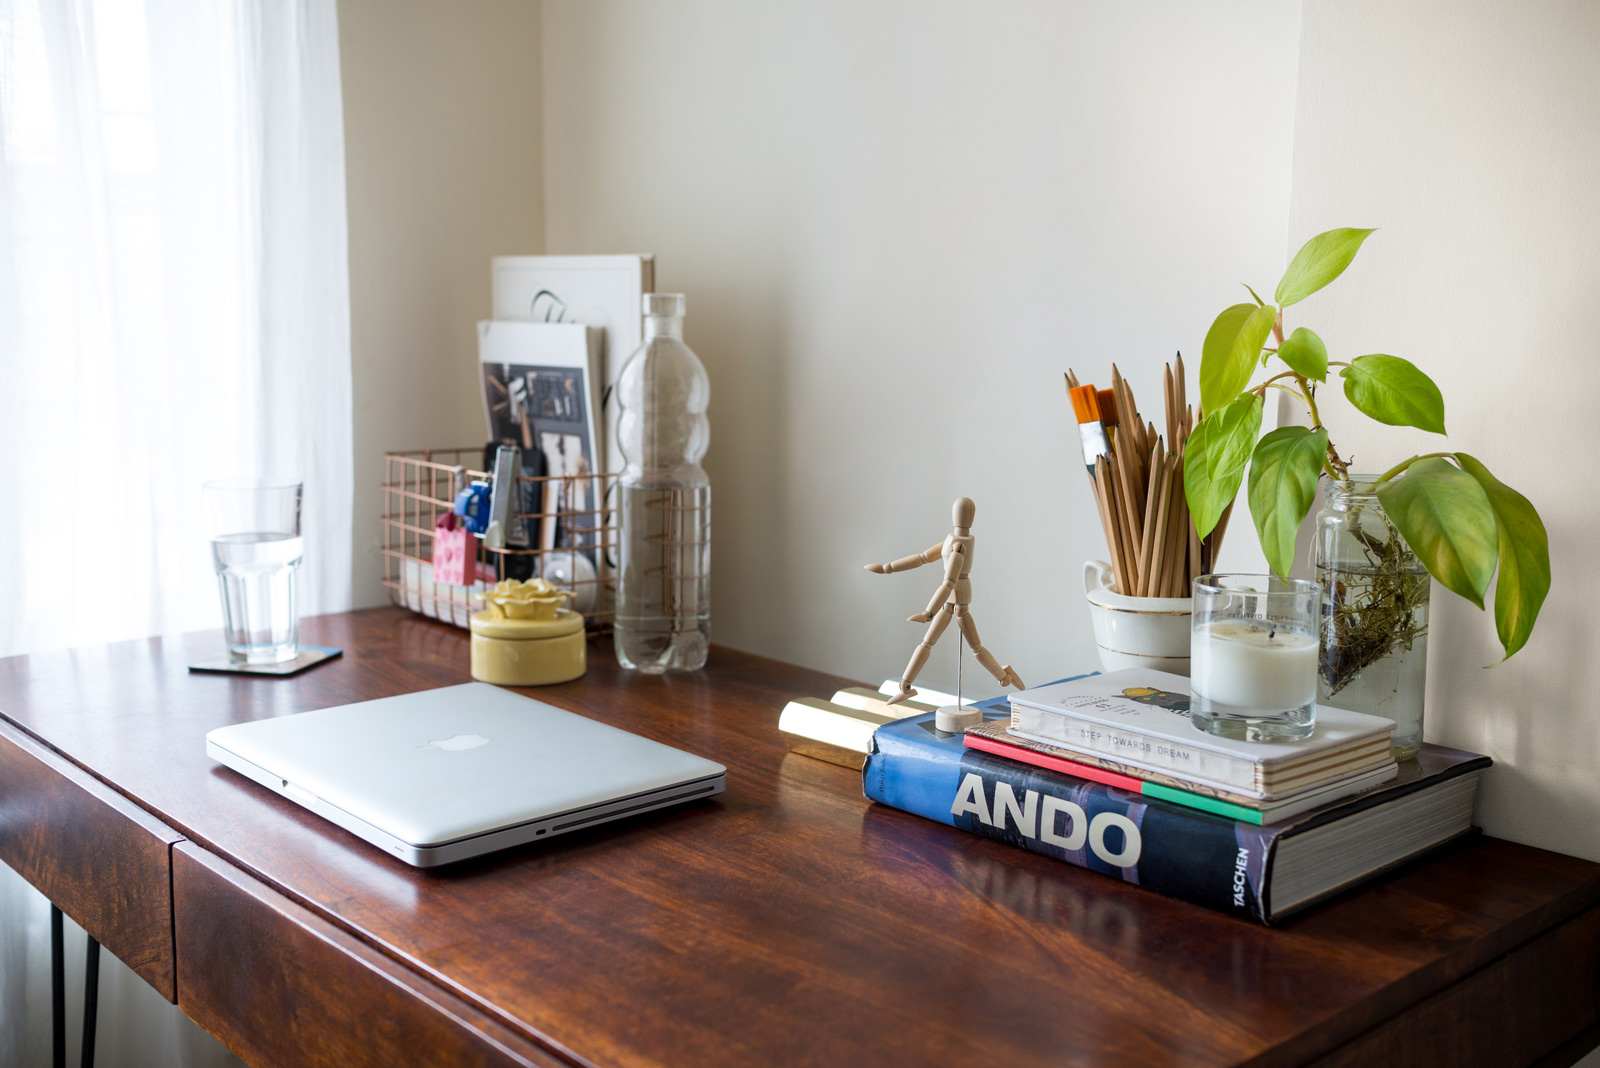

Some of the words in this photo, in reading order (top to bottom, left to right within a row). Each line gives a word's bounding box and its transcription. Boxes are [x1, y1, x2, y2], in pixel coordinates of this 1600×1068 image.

[1081, 729, 1102, 740] STEP
[1107, 735, 1151, 752] TOWARDS
[1158, 746, 1190, 760] DREAM
[950, 772, 1142, 868] ANDO
[1233, 847, 1250, 907] TASCHEN
